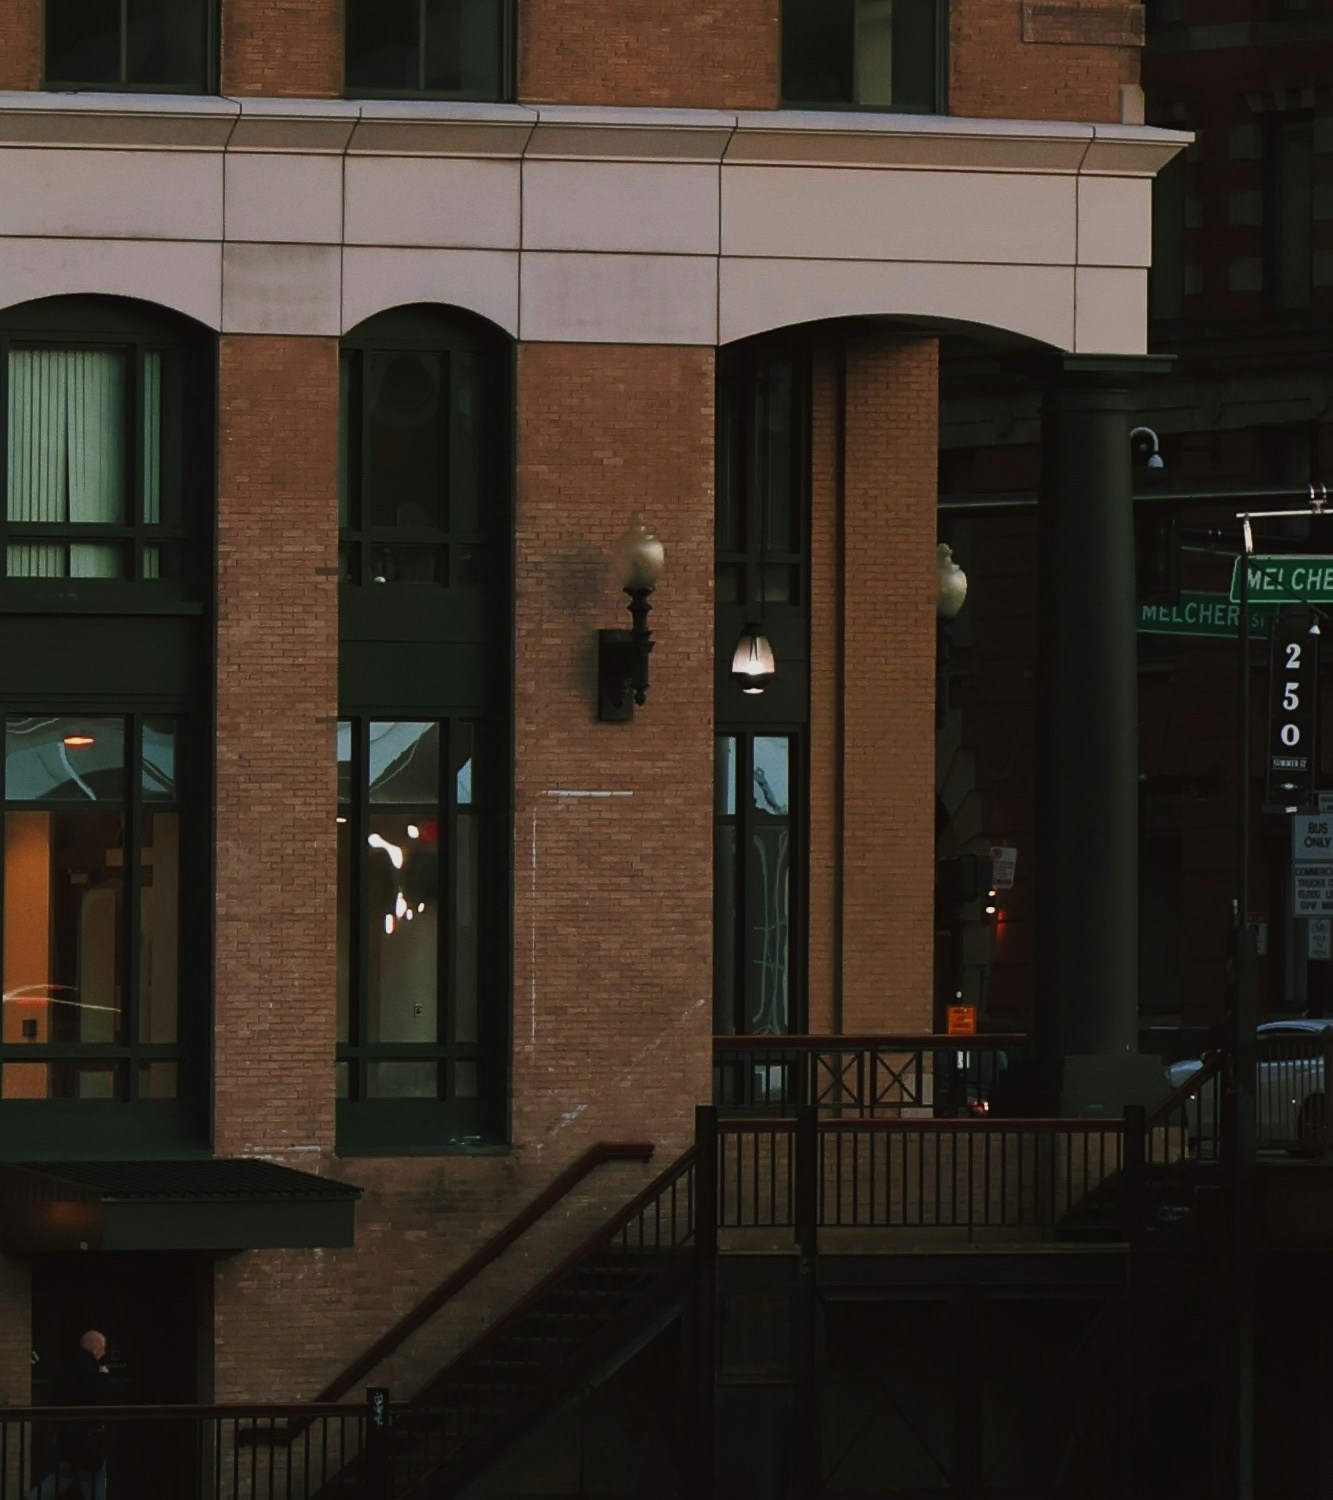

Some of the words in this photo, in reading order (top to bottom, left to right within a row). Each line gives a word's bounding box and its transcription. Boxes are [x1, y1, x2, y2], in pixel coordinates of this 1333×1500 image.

[1141, 602, 1240, 626] MELCHER
[1280, 642, 1302, 747] 250
[1308, 821, 1328, 834] BUS
[1304, 836, 1332, 848] ONLY
